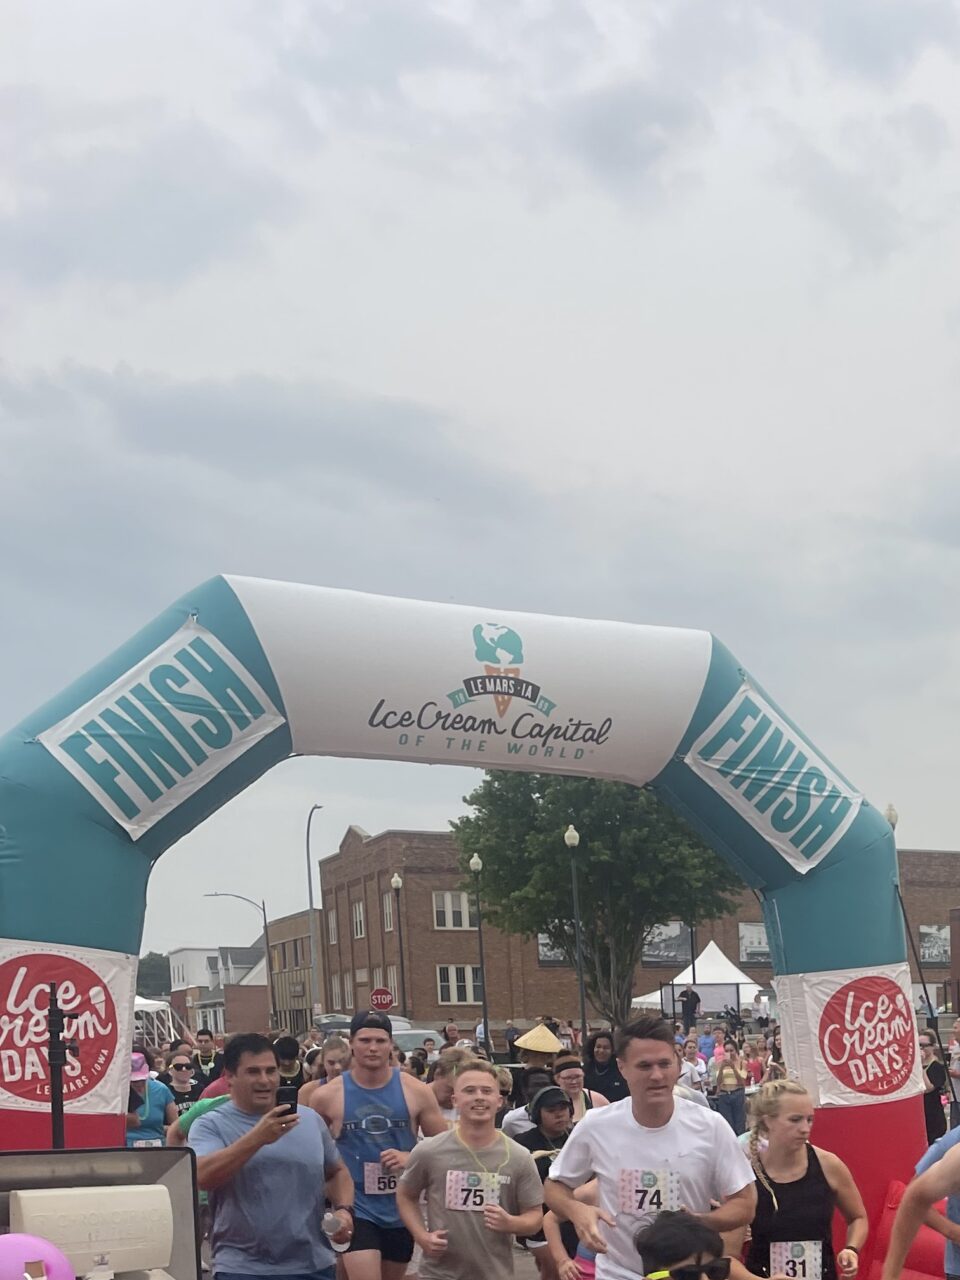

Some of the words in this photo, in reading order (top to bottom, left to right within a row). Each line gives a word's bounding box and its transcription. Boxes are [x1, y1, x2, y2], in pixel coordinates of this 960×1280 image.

[470, 679, 482, 694] LE
[486, 678, 515, 693] MARS
[521, 683, 533, 698] IA
[59, 636, 266, 821] FINISH
[368, 699, 415, 729] Ice
[417, 701, 507, 735] Cream
[511, 712, 613, 747] Capital
[398, 733, 425, 746] OF
[446, 737, 488, 751] THE
[507, 742, 585, 760] WORLD
[697, 695, 853, 861] FINISH
[6, 966, 82, 1015] Ice
[372, 995, 392, 1004] STOP
[845, 991, 893, 1031] Ice
[823, 1015, 911, 1065] Cream
[91, 1048, 109, 1076] IOWA
[849, 1044, 903, 1086] DAYS
[377, 1175, 397, 1191] 56
[461, 1188, 484, 1206] 75
[635, 1189, 662, 1210] 74
[785, 1259, 807, 1278] 31
